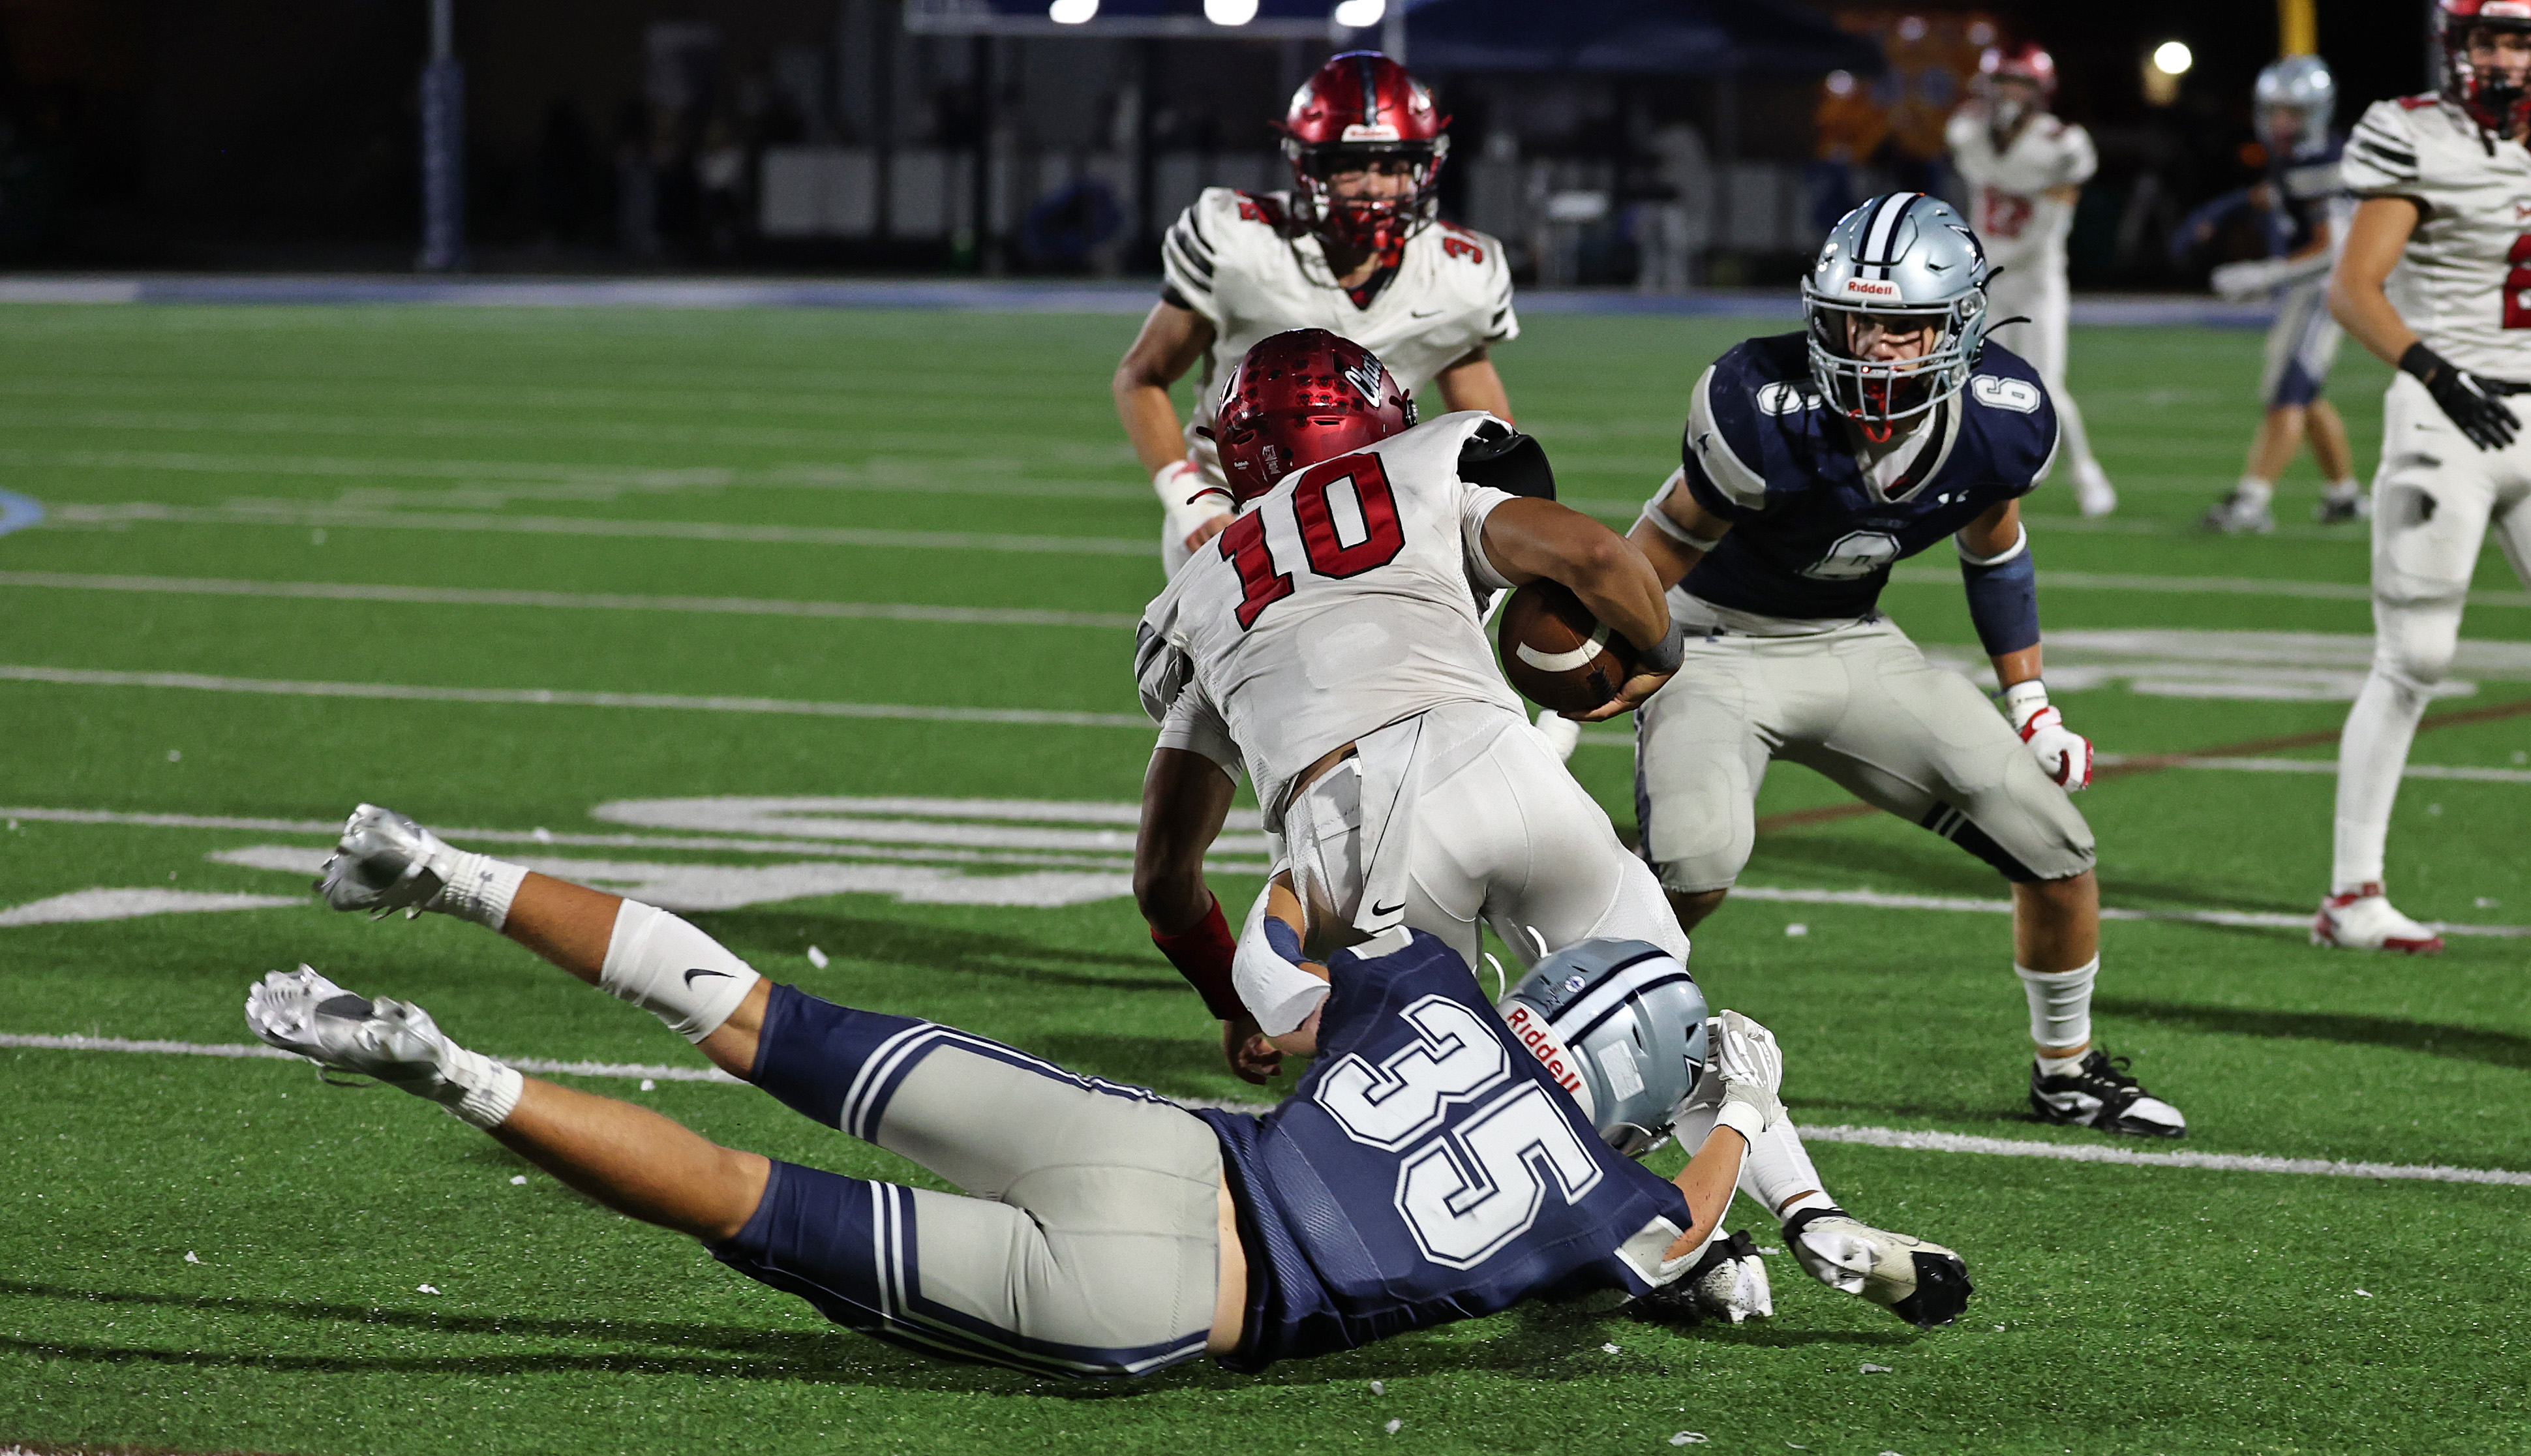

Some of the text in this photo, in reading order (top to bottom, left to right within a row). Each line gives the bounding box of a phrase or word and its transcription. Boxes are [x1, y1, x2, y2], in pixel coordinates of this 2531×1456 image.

[1847, 281, 1892, 295] Riddell
[1970, 373, 2042, 415] 6
[1218, 451, 1406, 631] 10
[1506, 1007, 1583, 1093] Riddell
[1312, 993, 1604, 1271] 35
